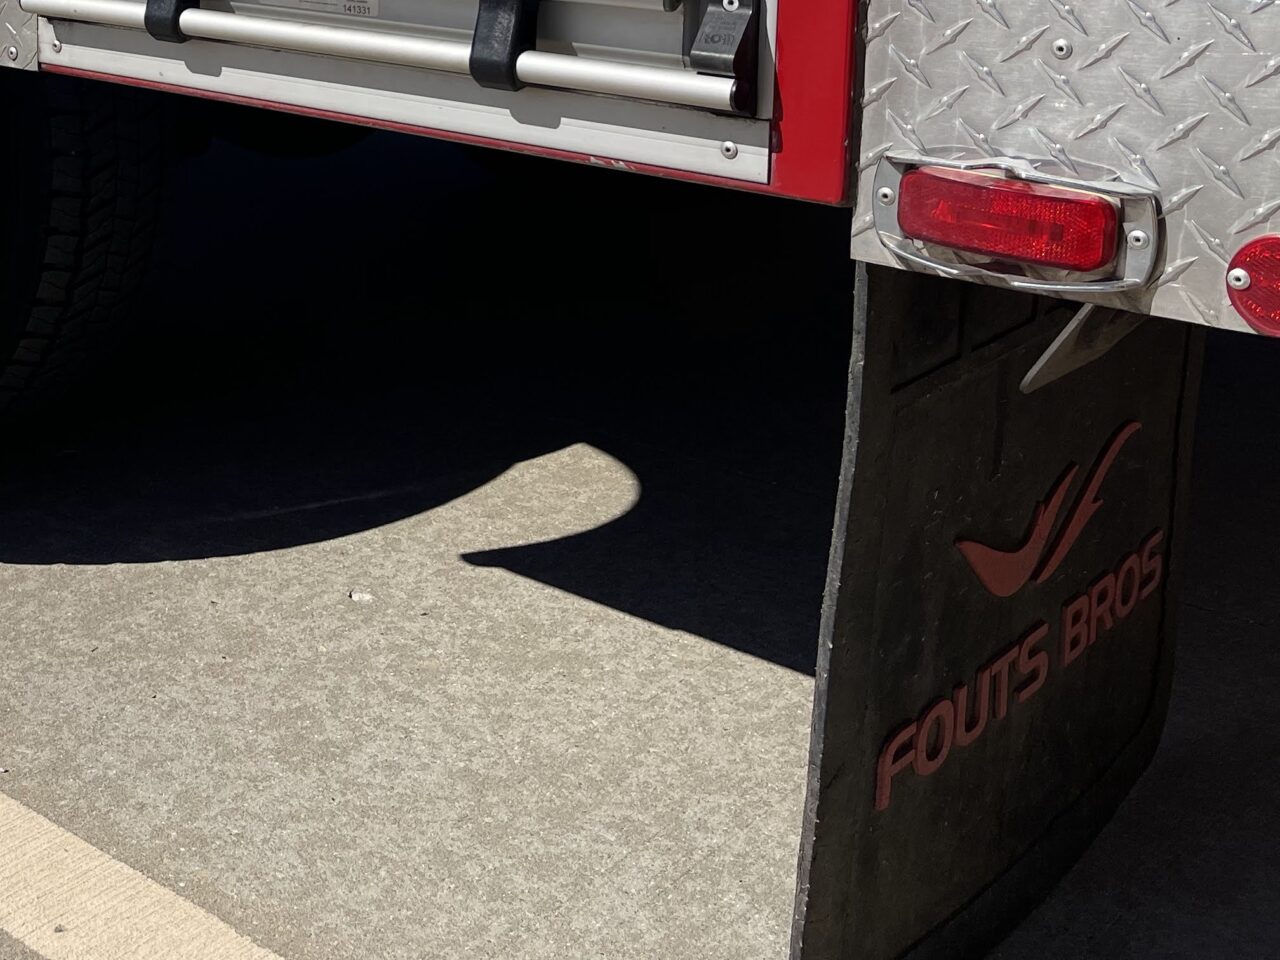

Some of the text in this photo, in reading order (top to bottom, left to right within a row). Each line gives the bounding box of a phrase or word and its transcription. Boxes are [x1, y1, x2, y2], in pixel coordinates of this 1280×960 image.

[343, 4, 370, 15] 141331
[874, 527, 1164, 811] FOUTS BROS
